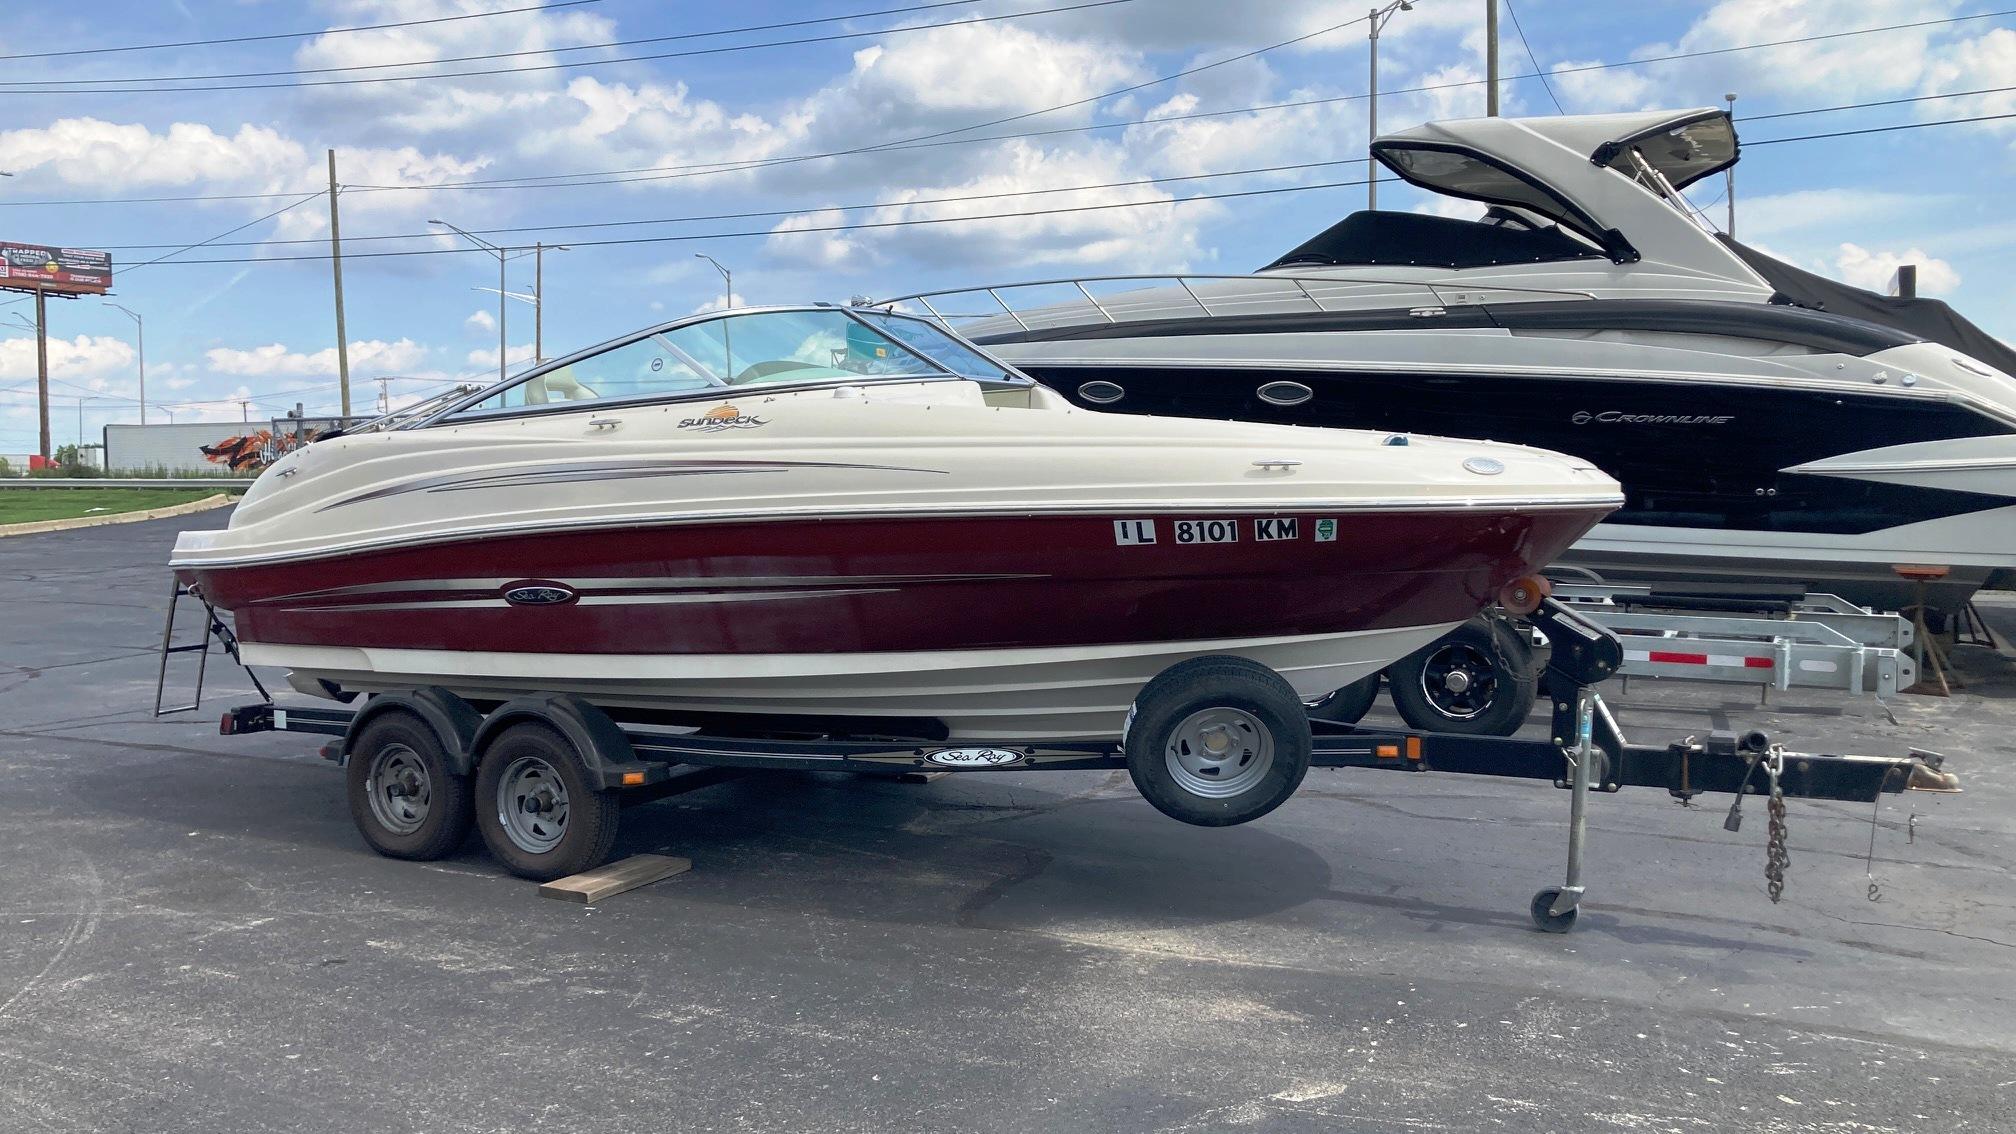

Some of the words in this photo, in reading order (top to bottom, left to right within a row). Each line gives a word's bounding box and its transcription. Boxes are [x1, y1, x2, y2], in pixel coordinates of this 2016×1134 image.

[1120, 521, 1155, 544] IL
[1177, 521, 1237, 543] 8101
[1256, 518, 1297, 540] KM
[513, 590, 535, 600] Sea
[537, 589, 562, 601] Ray
[942, 751, 971, 761] Sea
[974, 749, 1006, 763] Ray
